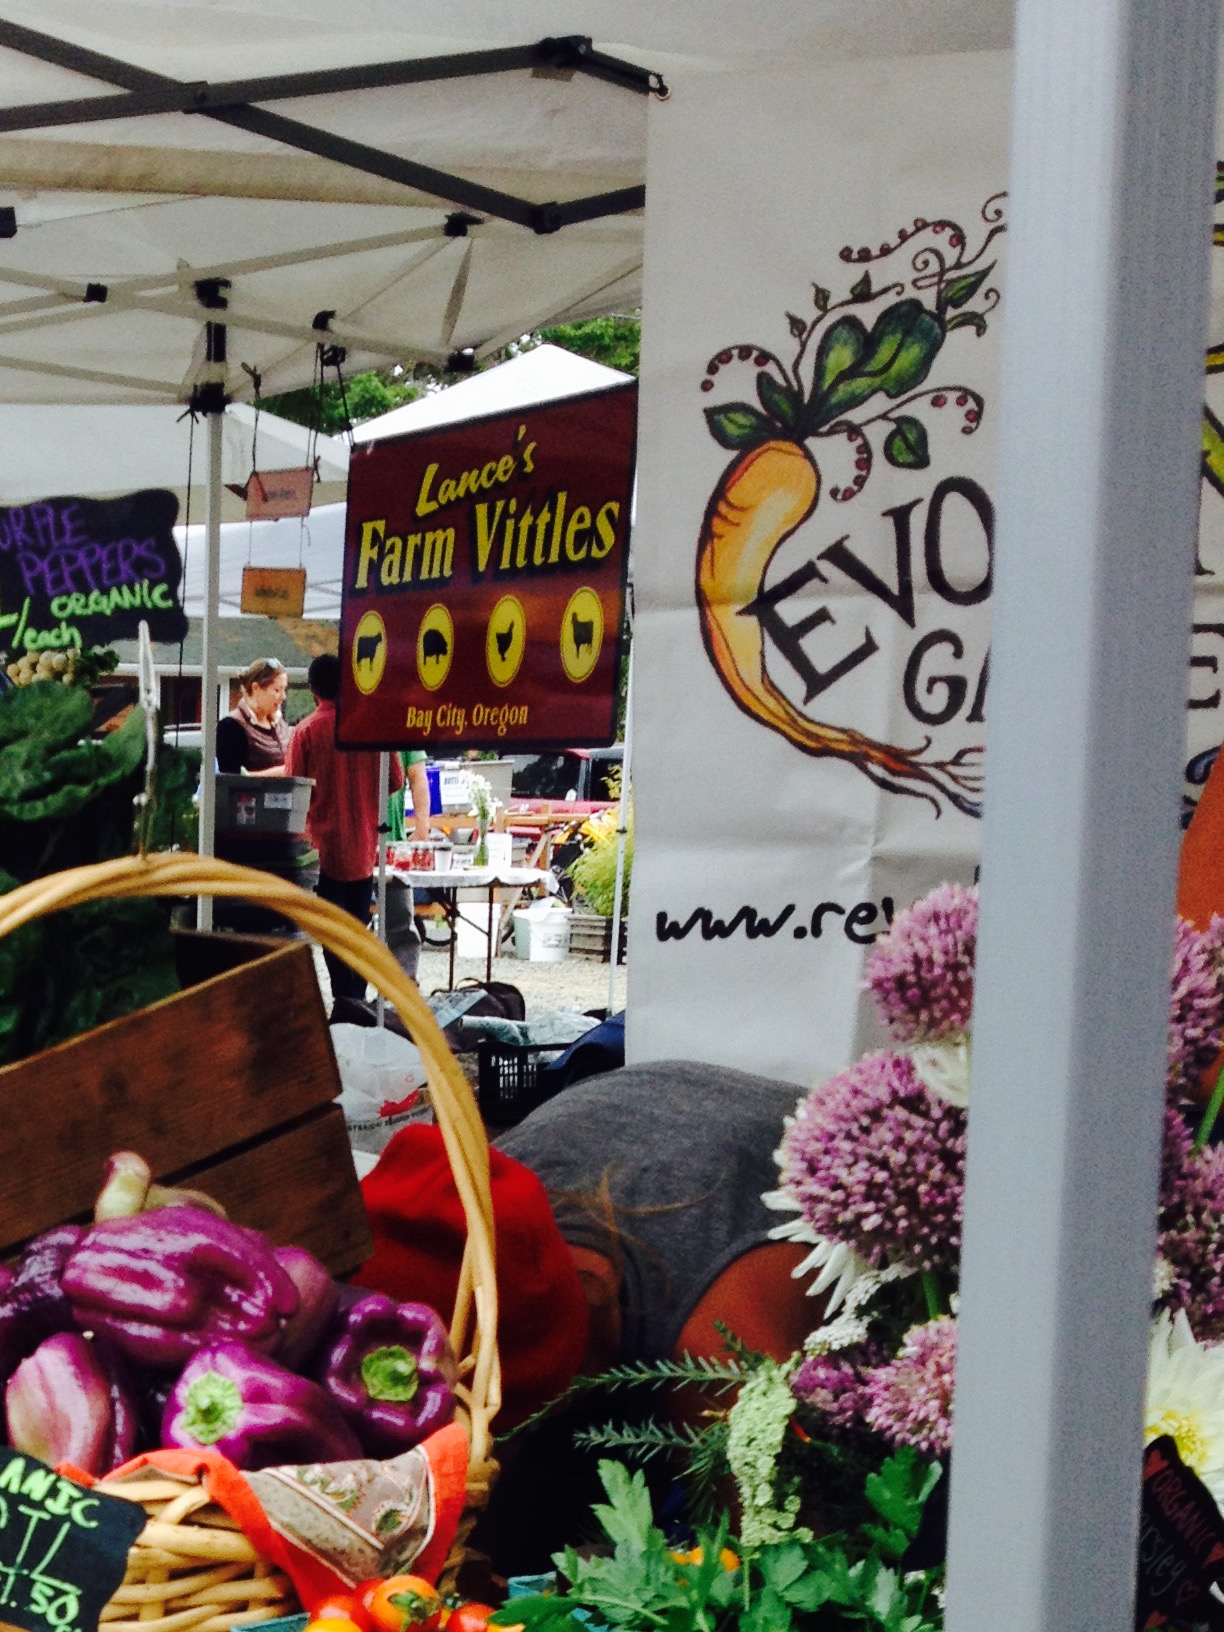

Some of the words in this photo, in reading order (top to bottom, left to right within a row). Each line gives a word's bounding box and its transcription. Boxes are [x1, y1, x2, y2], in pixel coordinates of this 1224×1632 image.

[415, 425, 537, 518] Lance's
[17, 537, 166, 597] PEPPERS
[355, 519, 456, 589] Farm
[475, 491, 620, 573] Vittles
[50, 578, 174, 618] ORGANIC
[406, 704, 433, 738] Bay
[472, 703, 529, 738] Oregon
[656, 896, 894, 944] www.re
[1152, 1469, 1217, 1553] ORGANIC
